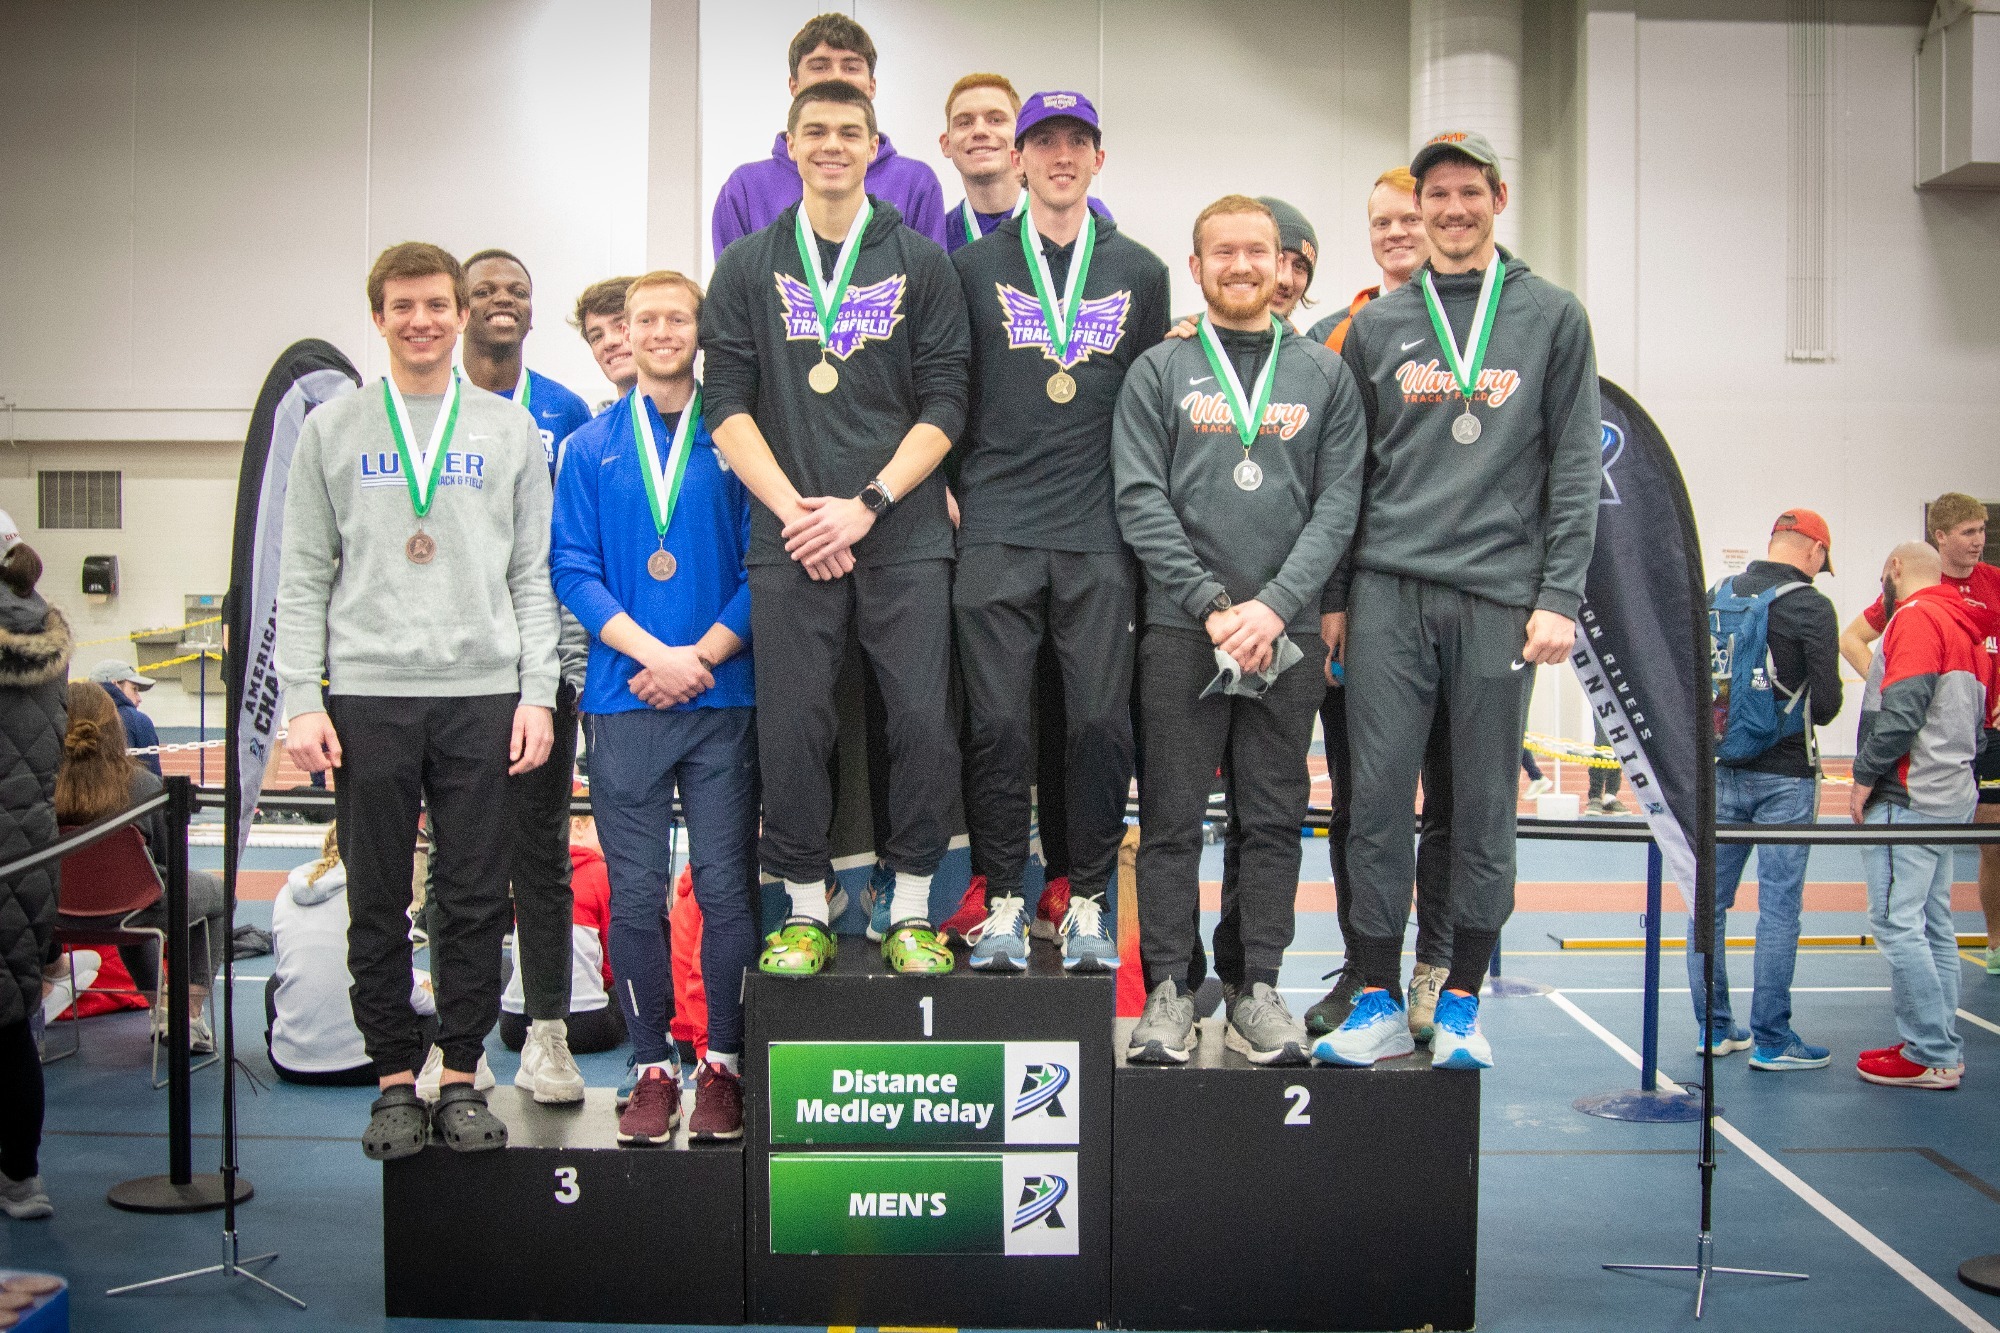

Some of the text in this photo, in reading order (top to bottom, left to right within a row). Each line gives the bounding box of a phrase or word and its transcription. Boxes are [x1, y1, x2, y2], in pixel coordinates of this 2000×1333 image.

[791, 318, 890, 335] TRAK&FIELD
[837, 310, 886, 320] COLLEGE
[1017, 318, 1048, 327] LORA
[1396, 358, 1521, 408] Warurg
[1403, 393, 1443, 403] TRACK
[1454, 390, 1489, 401] FLD
[1181, 390, 1310, 441] Waurg
[1193, 424, 1233, 434] TRACK
[361, 451, 485, 477] LUER
[464, 476, 484, 490] FIELD
[1603, 653, 1653, 741] RIVERS
[919, 996, 933, 1037] 1
[832, 1069, 958, 1094] Distance
[796, 1098, 995, 1130] Medley Relay
[1284, 1085, 1311, 1125] 2
[554, 1167, 580, 1204] 3
[849, 1192, 947, 1217] MEN'S
